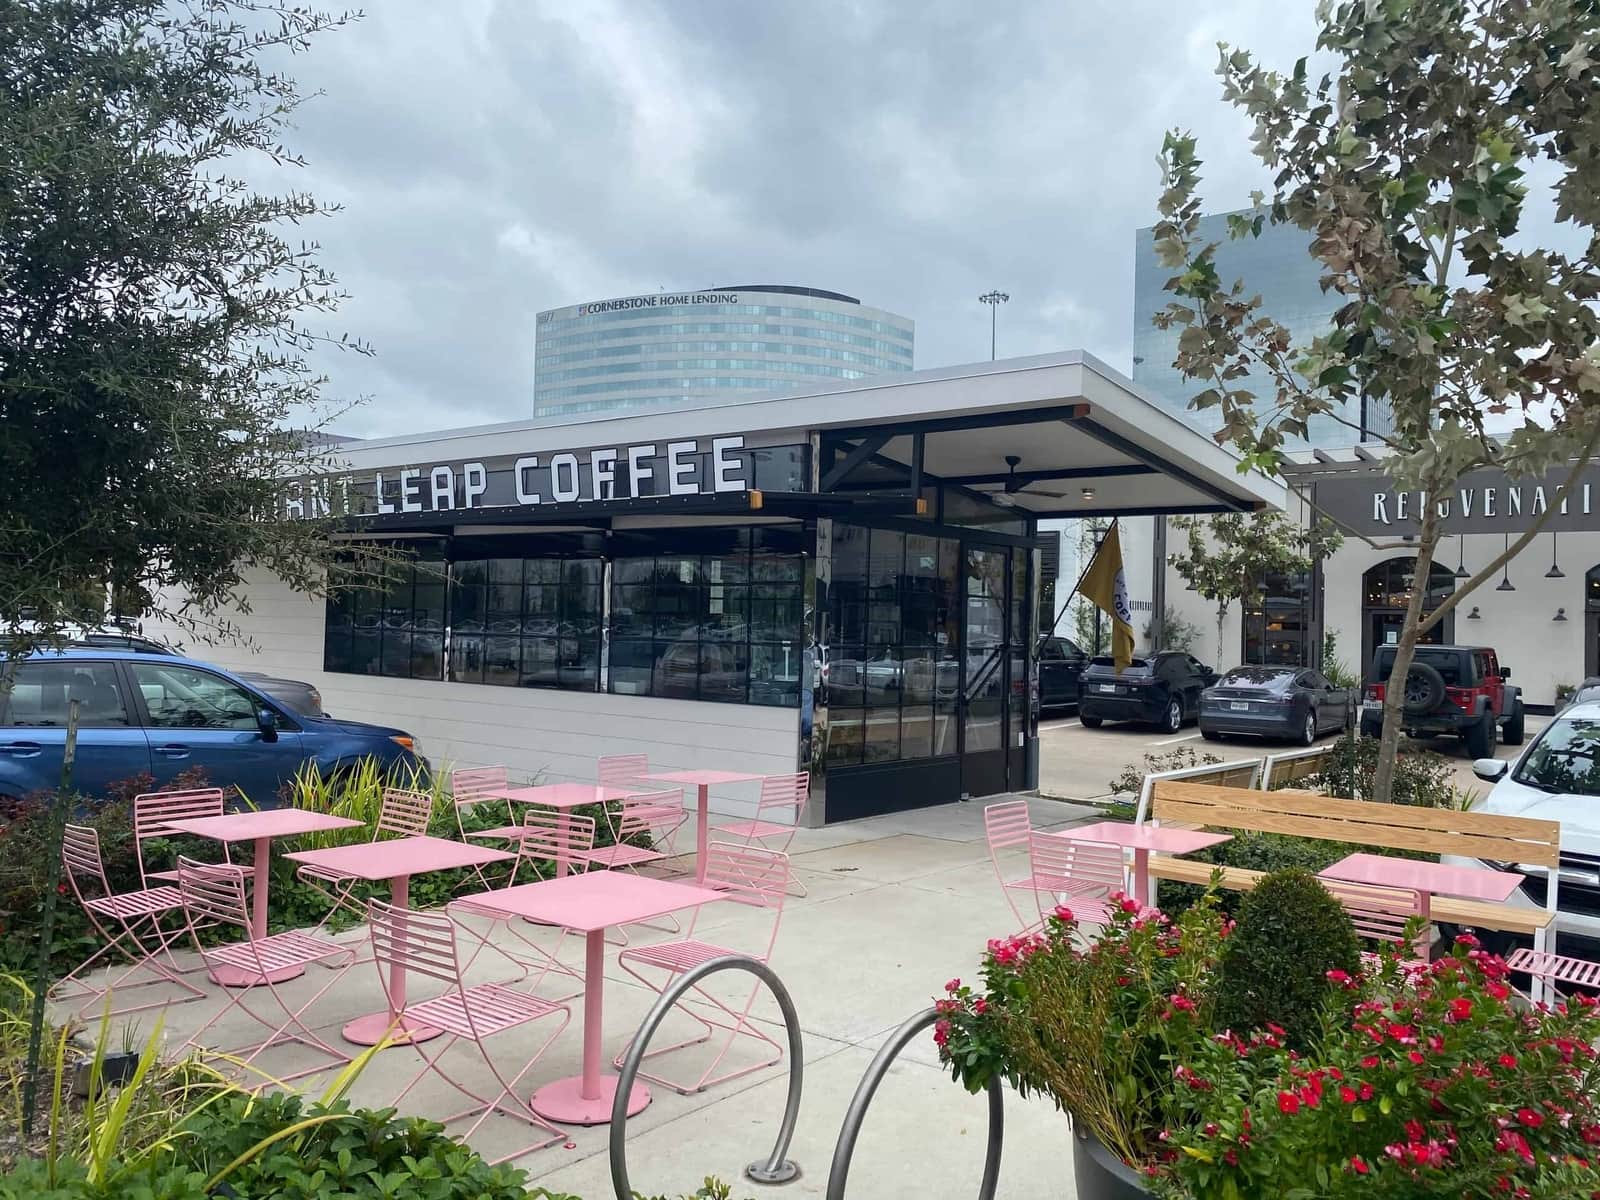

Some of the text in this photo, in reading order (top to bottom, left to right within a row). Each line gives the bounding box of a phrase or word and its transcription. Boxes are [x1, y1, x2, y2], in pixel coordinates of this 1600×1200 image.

[587, 294, 738, 314] CORNERSTONE HOME LENDING
[376, 462, 487, 514] LEAP
[514, 435, 745, 505] COFFEE
